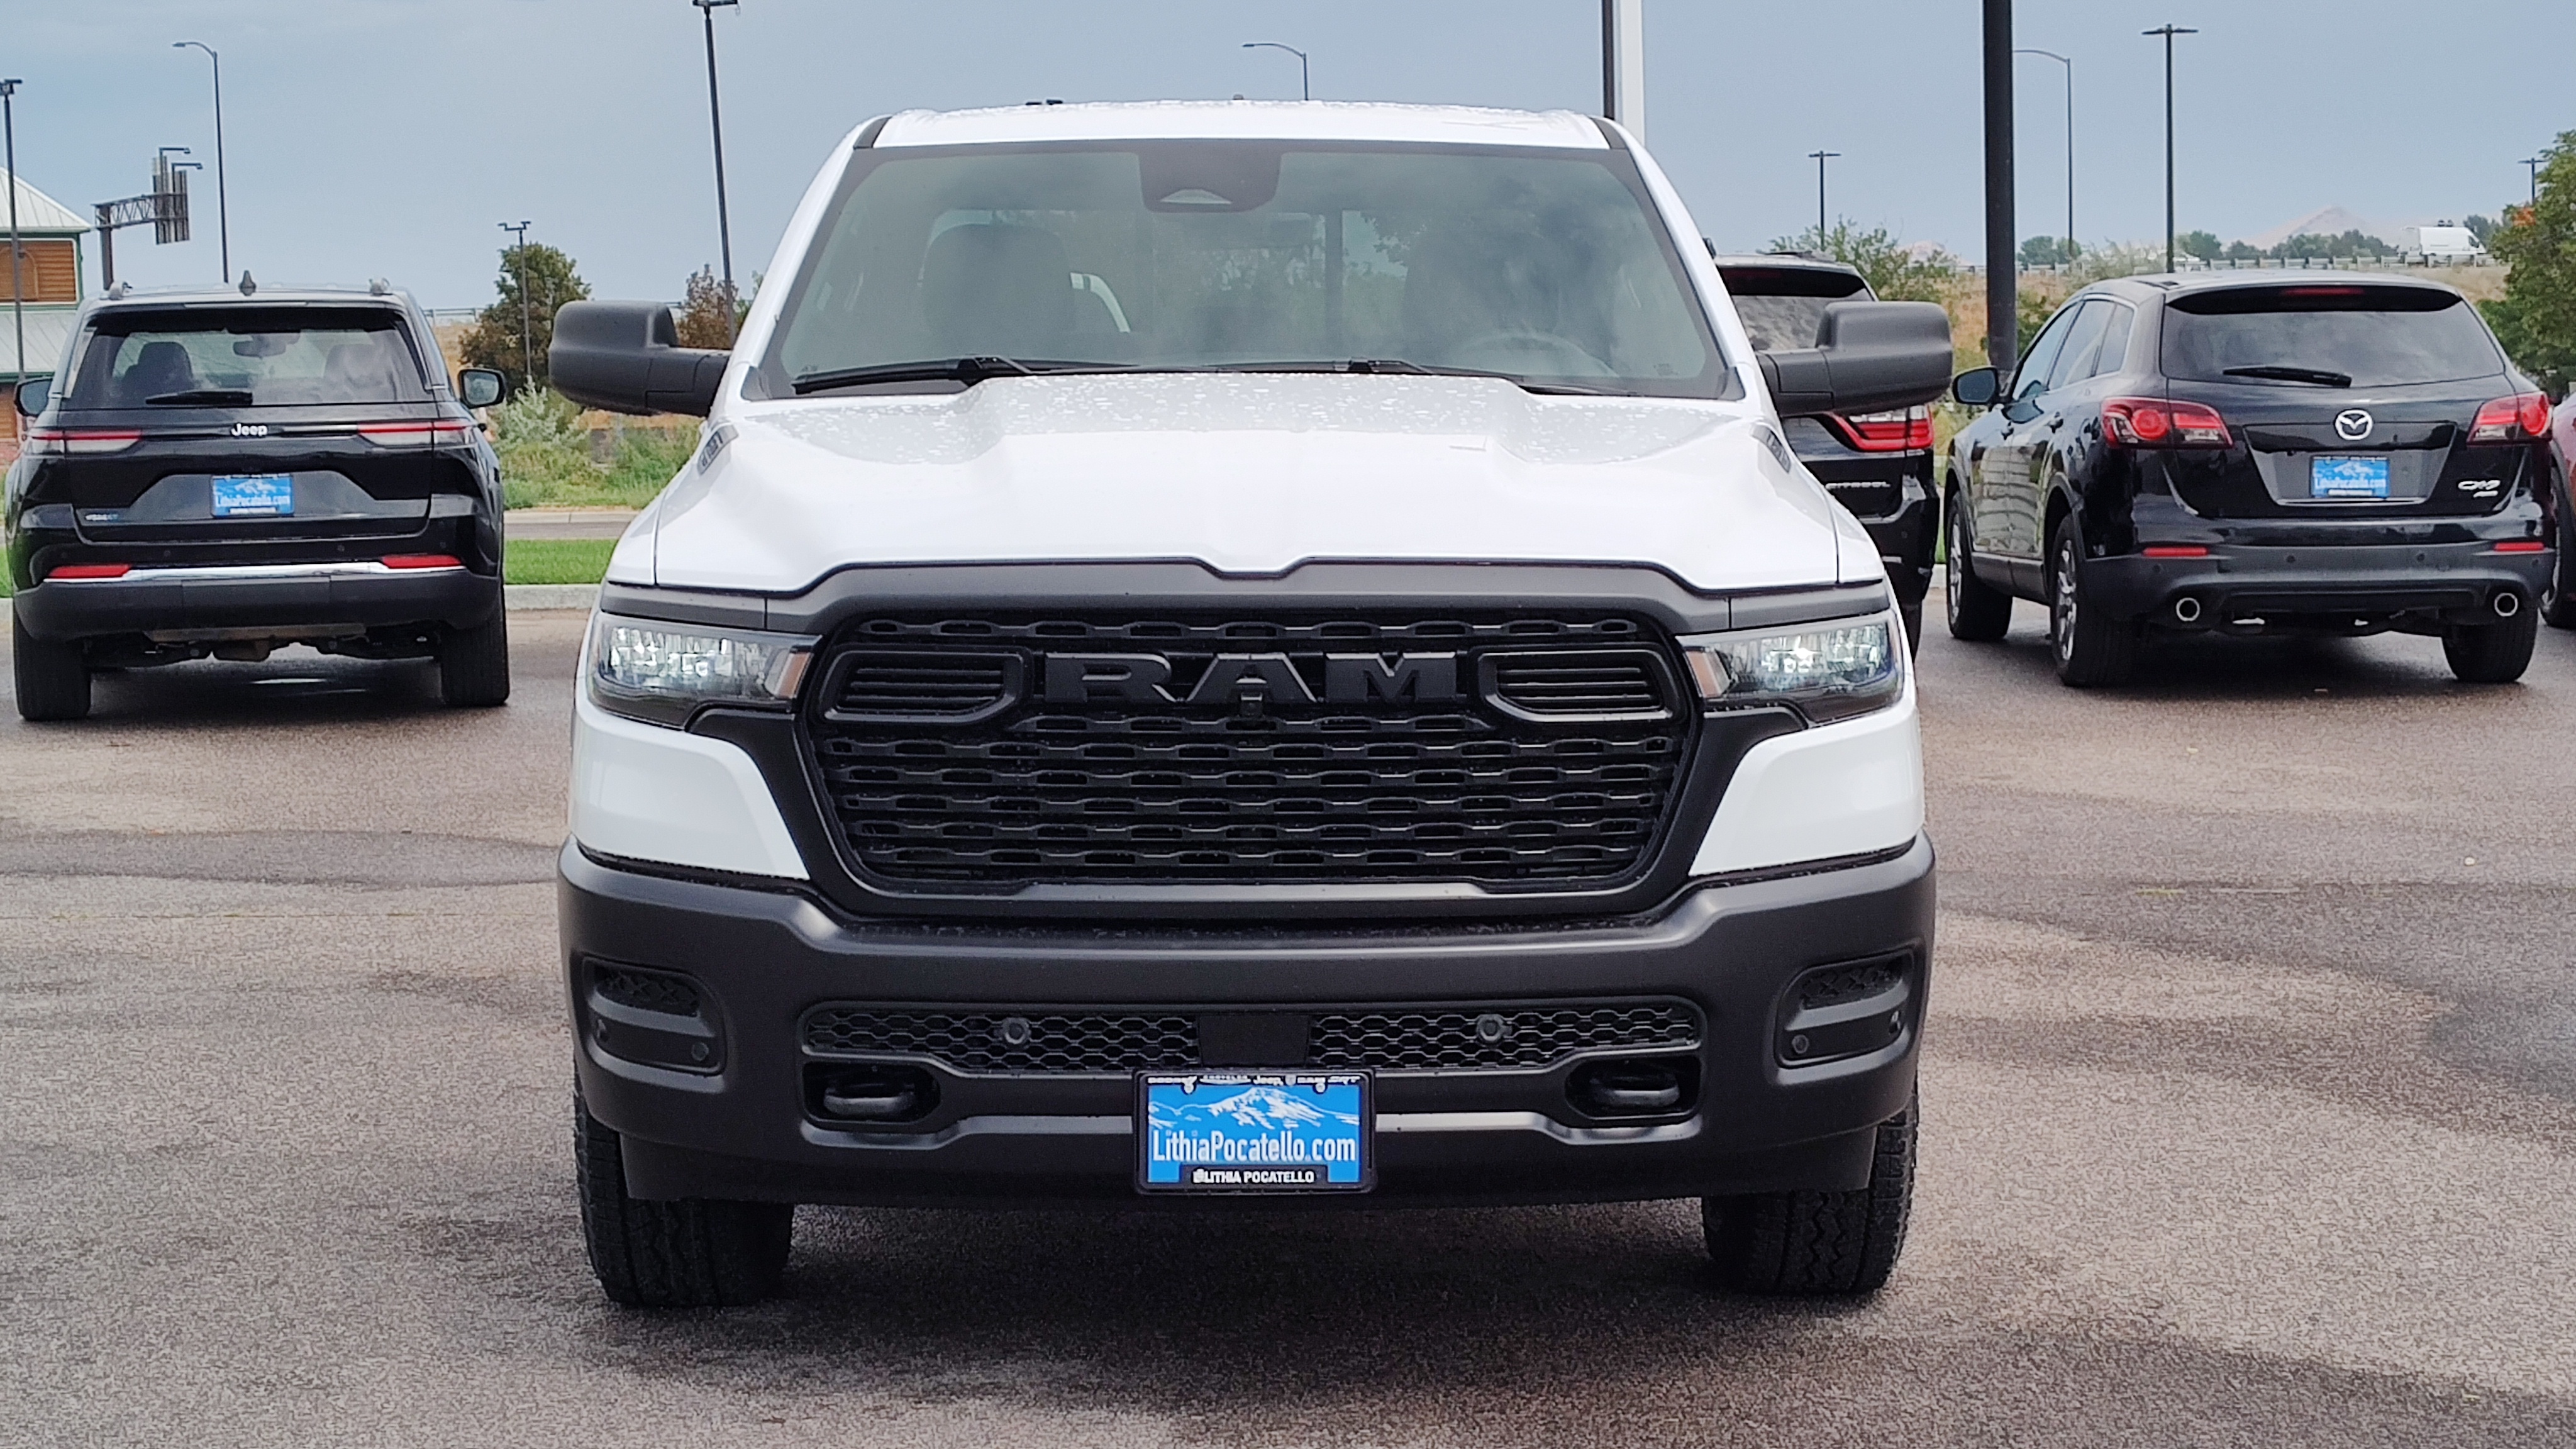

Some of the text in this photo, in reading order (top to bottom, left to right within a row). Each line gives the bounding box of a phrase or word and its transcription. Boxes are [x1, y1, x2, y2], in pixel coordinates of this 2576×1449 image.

[231, 423, 268, 436] Jeep
[1045, 652, 1457, 702] RAM
[1152, 1130, 1356, 1162] LithiaPocatello.com
[1204, 1170, 1314, 1184] LITHIA POCATELLO
